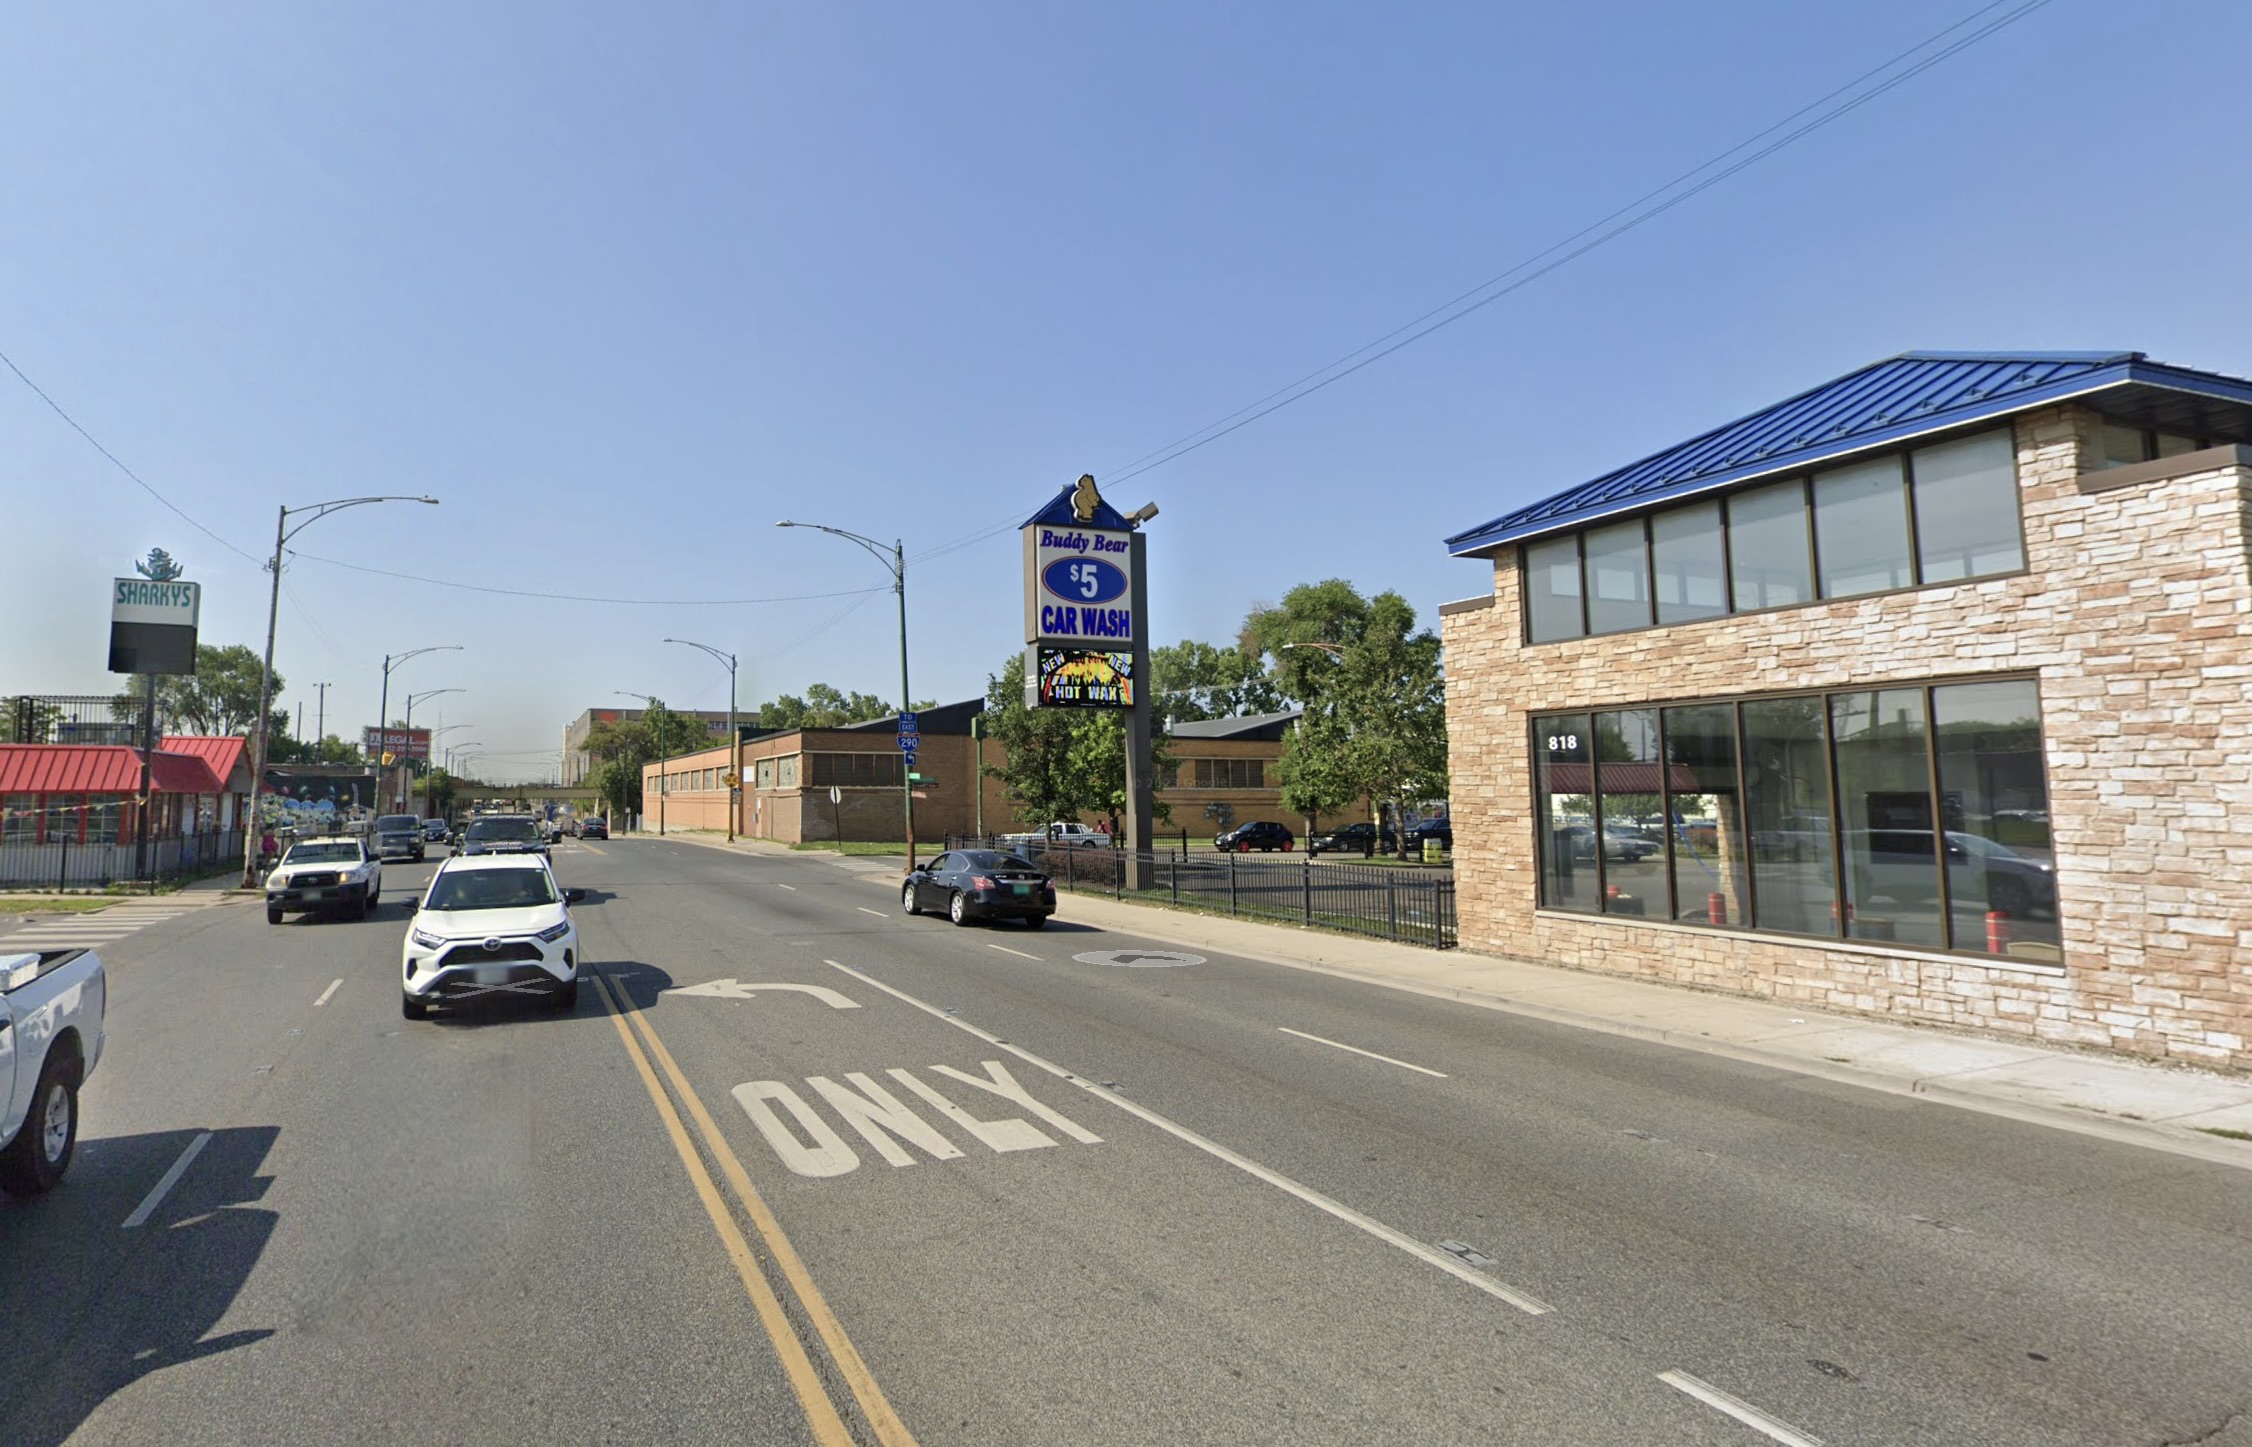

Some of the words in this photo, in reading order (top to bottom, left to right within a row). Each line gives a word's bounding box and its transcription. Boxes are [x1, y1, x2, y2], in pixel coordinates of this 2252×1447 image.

[1040, 530, 1089, 554] Buddy
[1092, 534, 1129, 553] Bear
[1070, 564, 1098, 598] $5
[117, 582, 191, 607] SHARKYS
[1041, 605, 1078, 635] CAR
[1081, 607, 1130, 638] WASH
[1042, 652, 1065, 674] NEW
[1108, 653, 1131, 677] NEW
[1055, 686, 1081, 699] HOT
[1088, 686, 1117, 701] WAX
[900, 738, 917, 748] 290
[1548, 735, 1577, 750] 818
[730, 1060, 1104, 1178] ONLY
